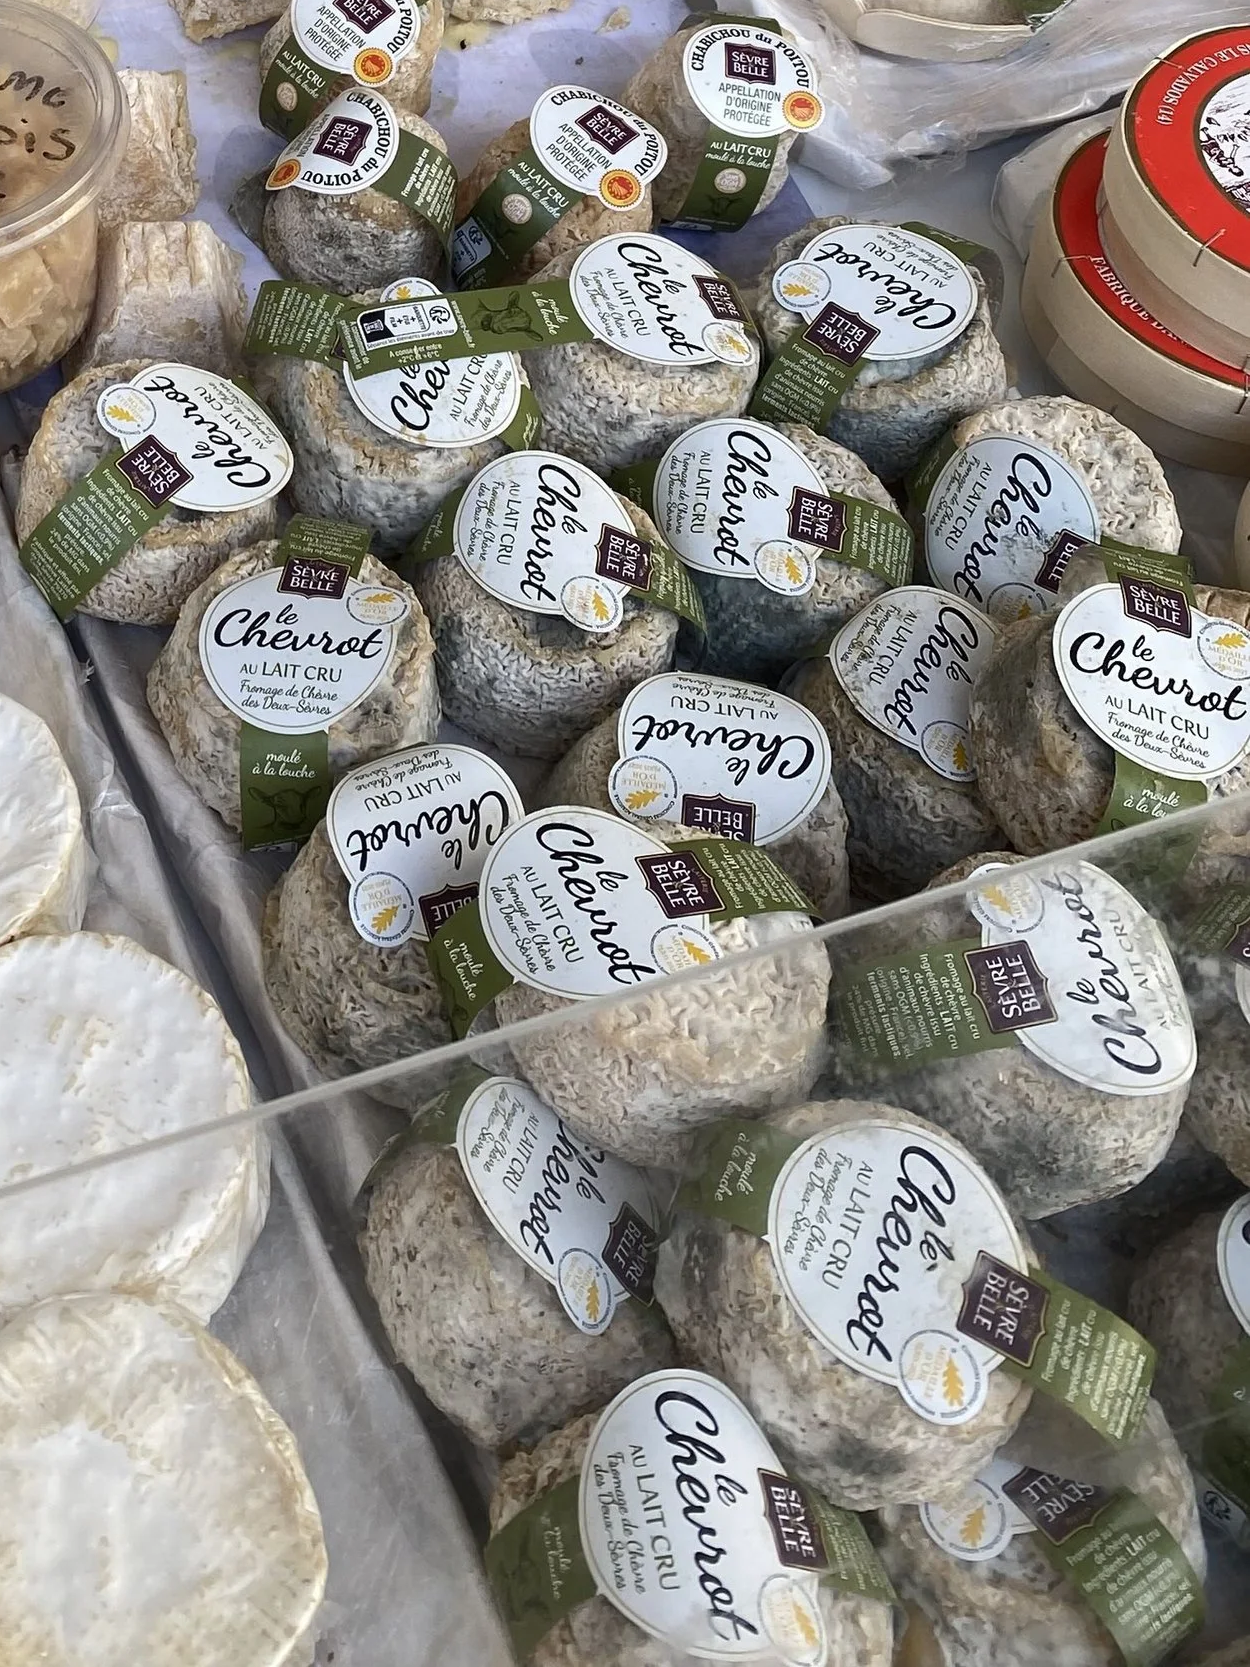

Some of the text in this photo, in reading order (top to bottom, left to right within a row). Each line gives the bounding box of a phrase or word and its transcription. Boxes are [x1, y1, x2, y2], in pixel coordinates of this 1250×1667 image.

[304, 27, 344, 62] PROTÉGÉE
[313, 18, 353, 53] D'ORIGINE
[316, 5, 367, 49] APPELLATION
[386, 8, 413, 54] POITOU
[691, 28, 810, 89] CHABICHOU du POITOU
[731, 51, 770, 67] SÈVRE
[733, 64, 769, 78] BELLE
[1213, 46, 1238, 63] LE
[718, 83, 781, 102] APPELLATION
[1168, 56, 1218, 108] CALVADOS
[723, 108, 772, 127] PROTÉGÉE
[726, 96, 772, 113] D'ORIGINE
[1155, 103, 1176, 126] (14)
[301, 91, 391, 186] CHABICHOU du POITOU
[322, 122, 346, 151] BELLE
[550, 90, 659, 177] CHABICHOU du POITOU
[559, 123, 613, 170] APPELLATION
[586, 118, 619, 146] BELLE
[593, 112, 628, 141] SÈVRE
[546, 143, 589, 183] PROTÉGÉE
[555, 135, 598, 173] D'ORIGINE
[710, 140, 772, 159] AU LAIT CRU
[518, 161, 570, 208] AU LAIT CRU
[618, 242, 705, 357] Chevrot
[663, 279, 687, 294] le
[813, 242, 957, 330] Chevrot
[874, 295, 897, 315] le
[144, 375, 271, 488] Chevrot
[191, 440, 215, 460] le
[144, 445, 180, 485] BELLE
[714, 430, 772, 567] Chevrot
[752, 480, 779, 500] le
[520, 464, 581, 602] Chevrot
[563, 515, 587, 534] le
[953, 452, 1053, 603] Chevrot
[290, 577, 335, 592] BELLE
[291, 563, 340, 582] SÈVRE
[276, 603, 298, 625] le
[1130, 585, 1180, 611] SÈVRE
[1134, 599, 1181, 626] BELLE
[214, 608, 383, 659] Chevrot
[1132, 635, 1155, 661] le
[240, 662, 343, 682] AU LAIT CRU
[240, 680, 338, 701] Fromage de Chèvre
[883, 607, 979, 736] Chevrot
[1069, 632, 1247, 720] Chevrot
[242, 696, 332, 715] des Deux-Sèvres
[1105, 695, 1210, 740] AU LAIT CRU
[266, 749, 302, 764] moulé
[632, 715, 815, 779] Chevrot
[346, 791, 509, 872] Chevrot
[693, 806, 743, 829] BELLE
[599, 870, 629, 892] le
[651, 864, 687, 909] BELLE
[667, 860, 706, 907] SÈVRE
[536, 822, 656, 985] Chevrot
[986, 956, 1023, 1019] SÈVRE
[1004, 954, 1041, 1013] BELLE
[1040, 869, 1162, 1074] Chevrot
[846, 1146, 956, 1362] Chevrot
[973, 1270, 1007, 1332] BELLE
[994, 1279, 1030, 1346] SÈVRE
[715, 1474, 748, 1507] le
[629, 1444, 680, 1590] AU LAIT CRU
[655, 1391, 758, 1641] Chevrot
